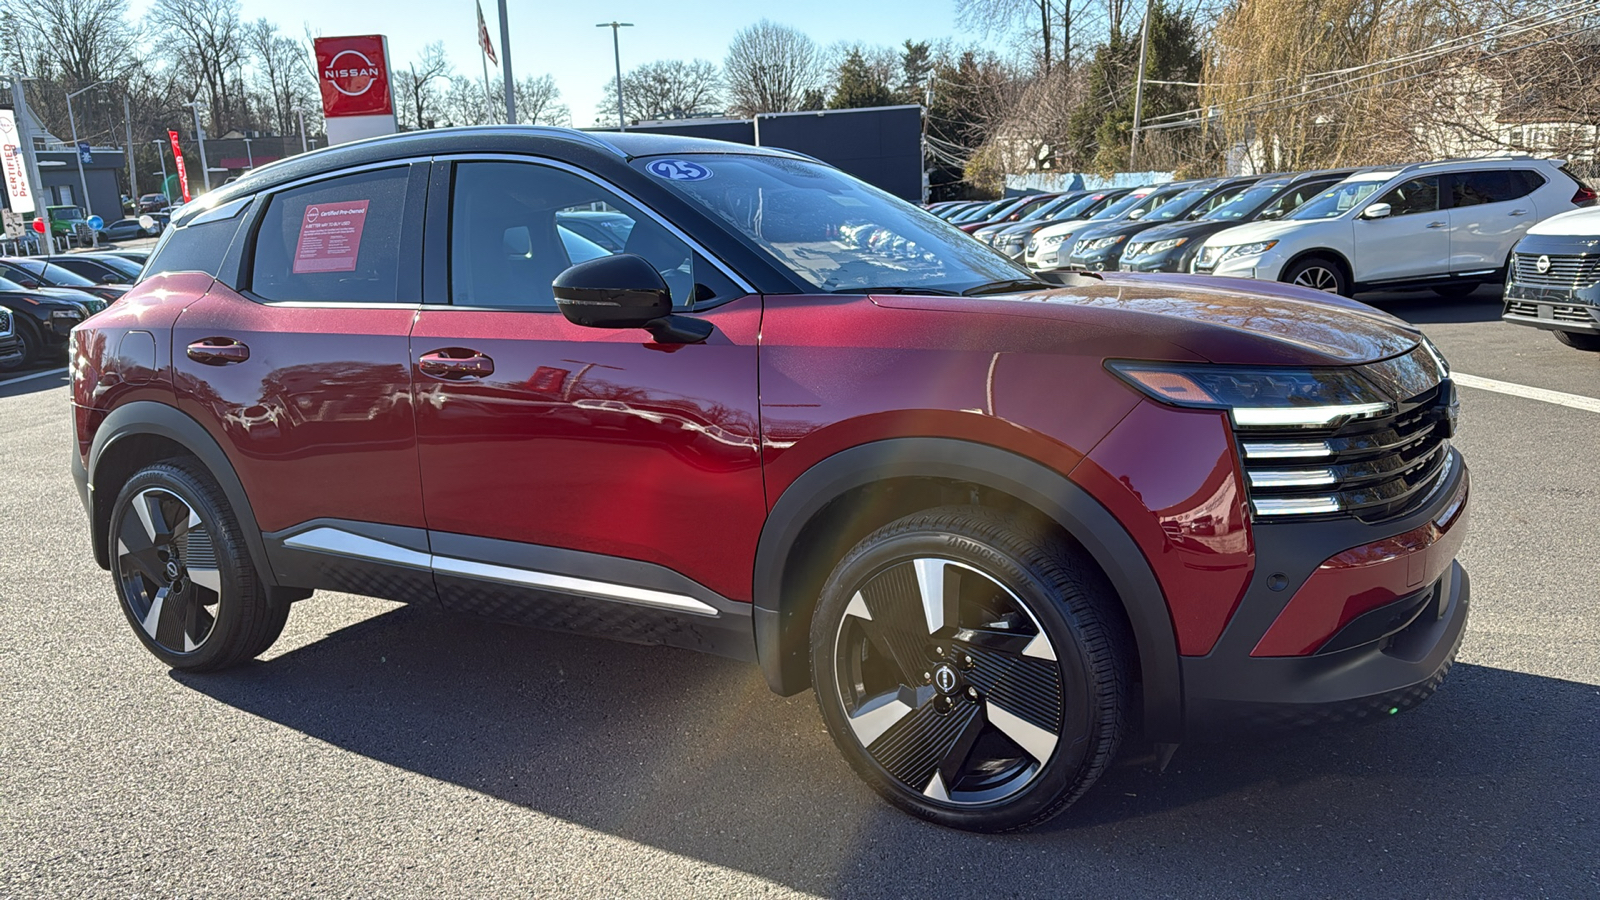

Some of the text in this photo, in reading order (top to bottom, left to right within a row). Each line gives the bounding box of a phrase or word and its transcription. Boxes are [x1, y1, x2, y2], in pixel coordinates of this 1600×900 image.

[325, 67, 378, 79] NISSAN
[3, 144, 18, 197] CERTIFIED
[658, 160, 701, 179] 25
[946, 536, 1035, 589] BRIDGESTONE
